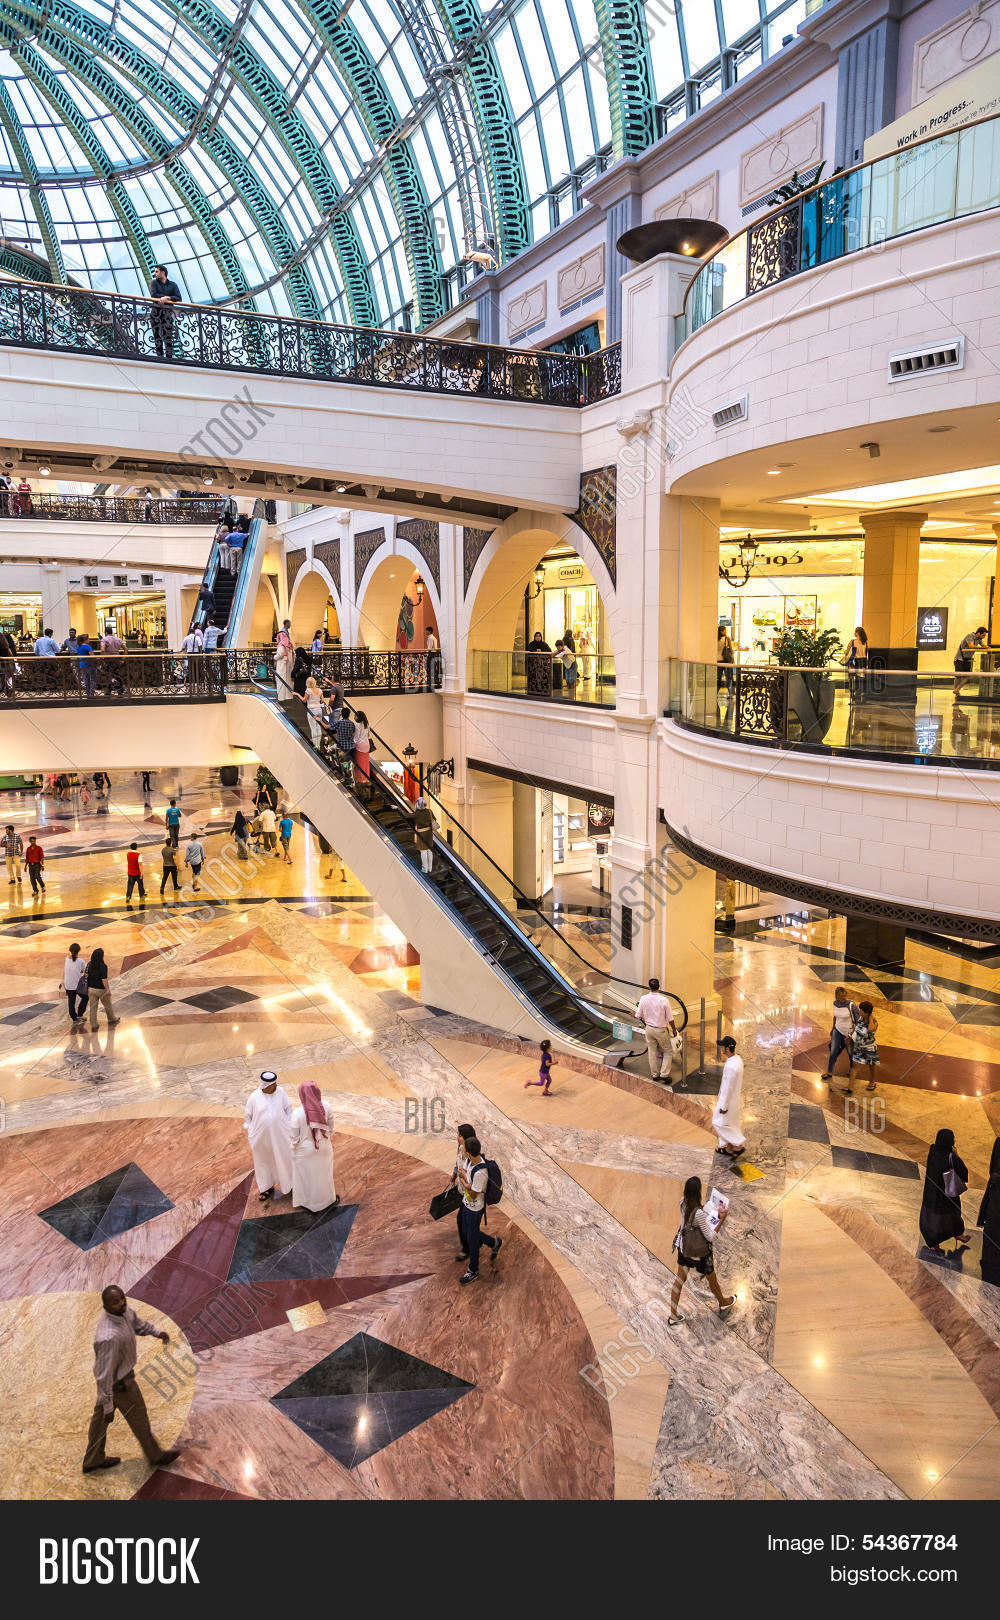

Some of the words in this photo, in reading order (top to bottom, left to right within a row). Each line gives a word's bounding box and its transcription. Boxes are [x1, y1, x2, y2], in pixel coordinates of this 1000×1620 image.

[896, 130, 918, 148] Work
[919, 124, 928, 136] in
[929, 99, 975, 129] Progress...
[560, 568, 581, 576] COACH
